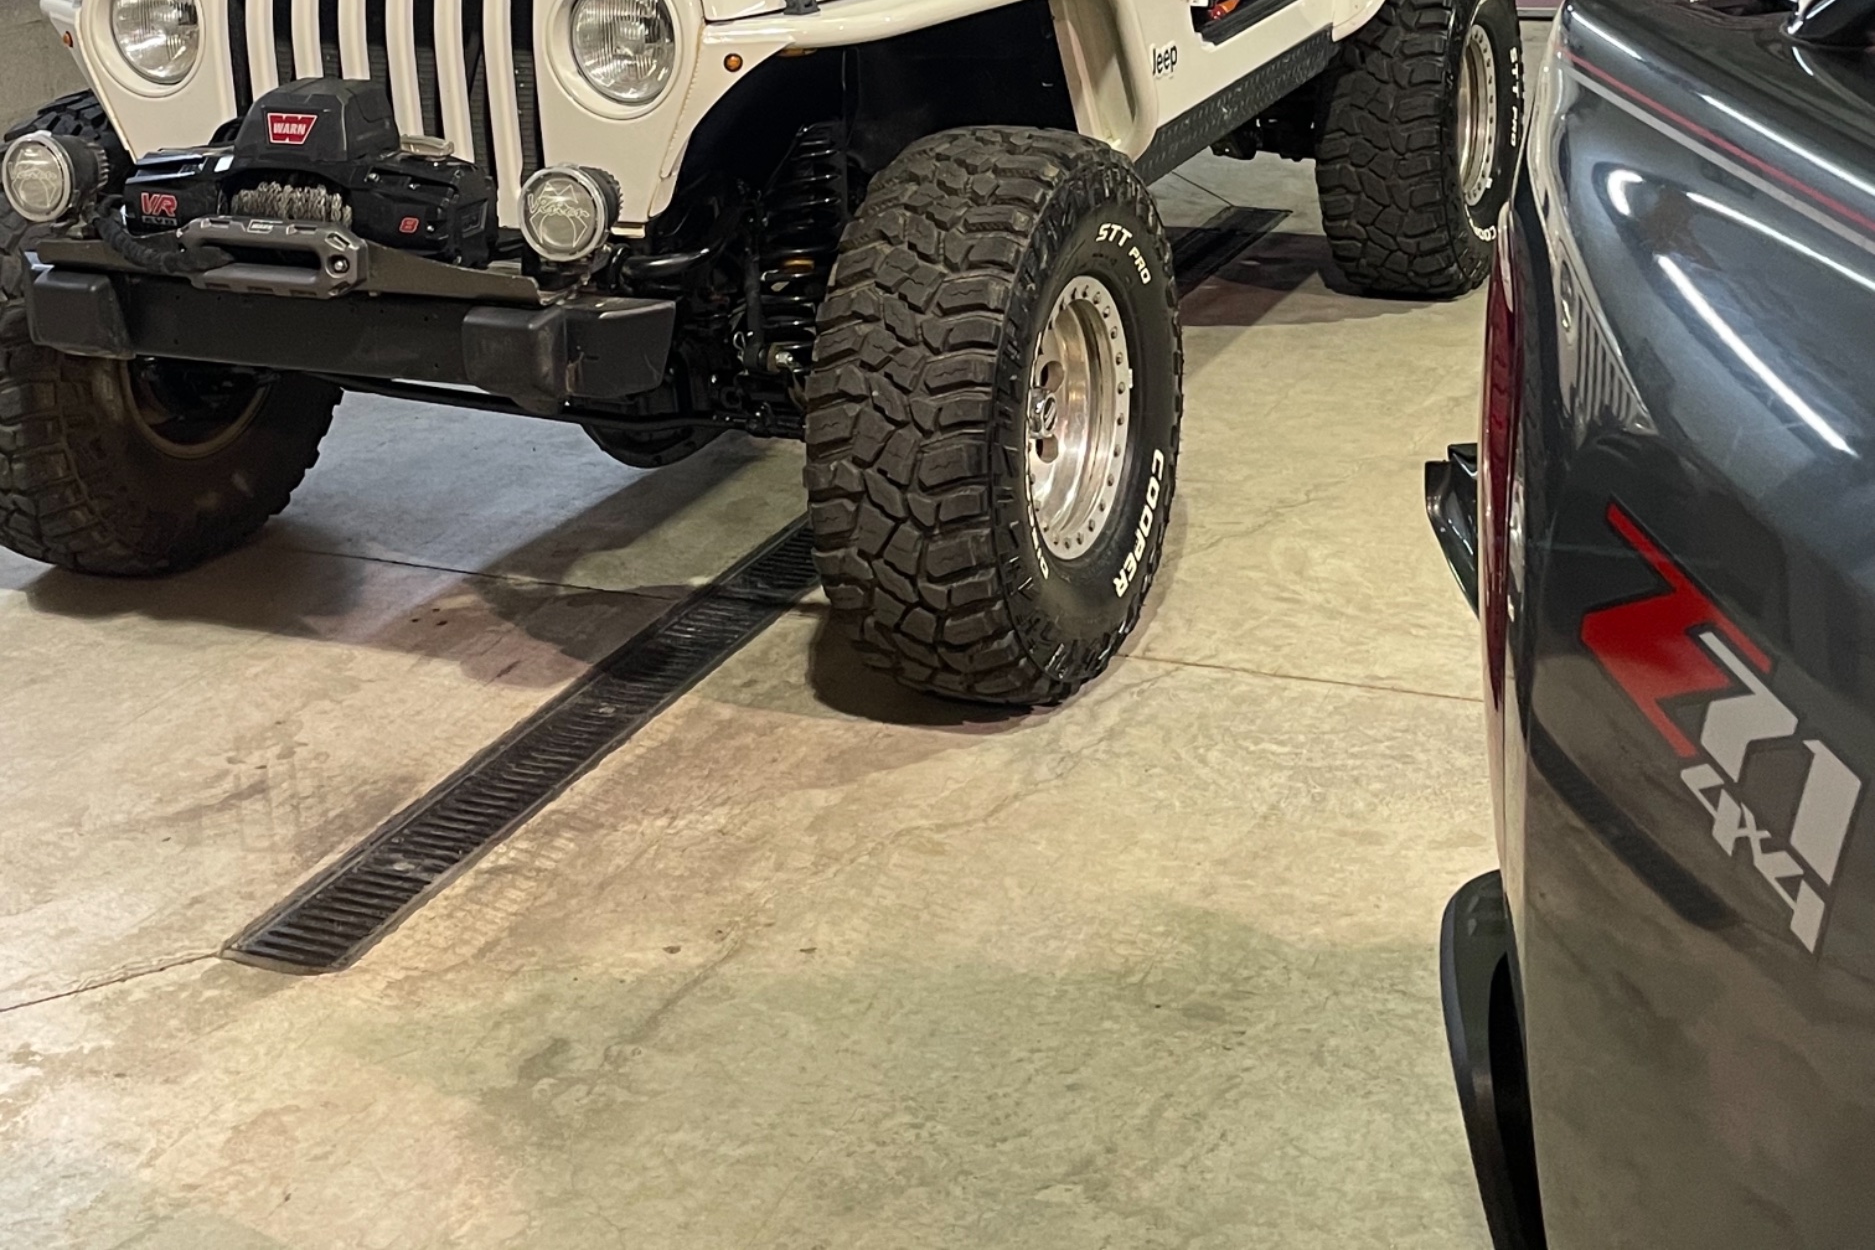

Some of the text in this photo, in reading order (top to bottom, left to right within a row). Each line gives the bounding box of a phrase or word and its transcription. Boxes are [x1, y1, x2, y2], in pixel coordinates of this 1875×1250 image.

[1152, 45, 1177, 76] Jeep
[273, 123, 307, 135] WARN
[141, 192, 177, 217] VR
[399, 217, 419, 233] 8
[1096, 222, 1133, 247] STT
[1128, 246, 1152, 285] PRO
[1113, 449, 1164, 598] COOPER
[1580, 502, 1862, 887] Z71
